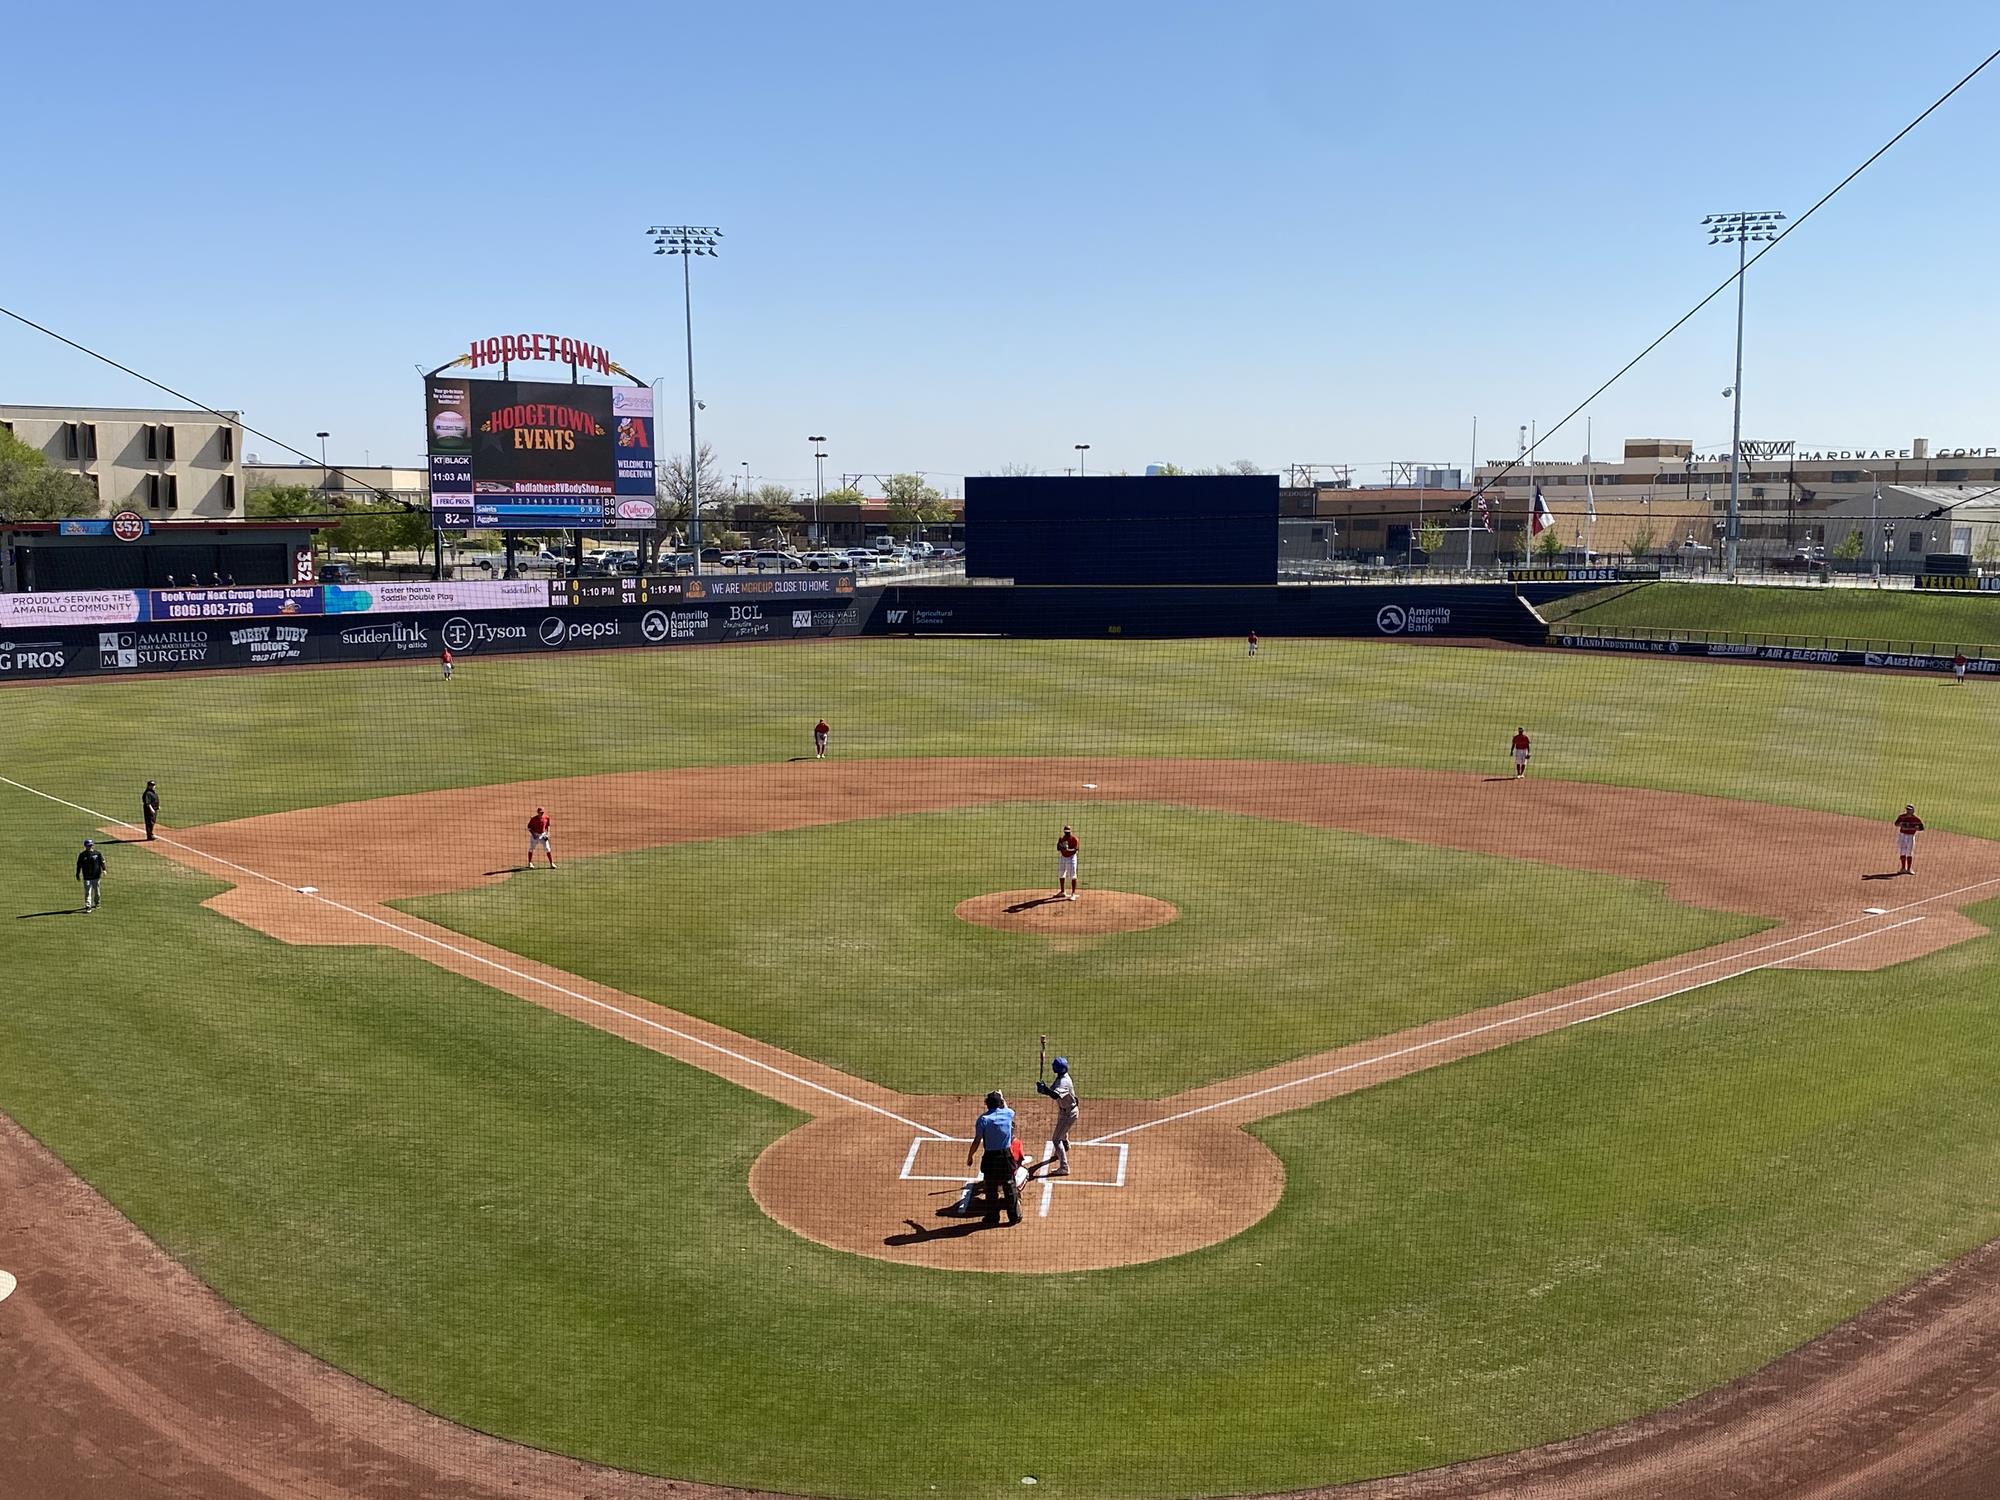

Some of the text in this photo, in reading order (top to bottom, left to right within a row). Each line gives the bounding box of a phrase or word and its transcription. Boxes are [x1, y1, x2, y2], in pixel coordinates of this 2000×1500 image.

[470, 333, 609, 376] HODGETOWN
[491, 404, 595, 436] HODGETOWN
[514, 428, 574, 450] EVENTS
[1799, 450, 1910, 460] HARDWARE
[1939, 448, 1997, 458] COMP
[618, 460, 652, 468] WELCOME TO
[433, 472, 454, 480] 11:03
[619, 470, 652, 478] HODGETOWN
[445, 514, 460, 524] 82
[116, 521, 140, 532] 352
[297, 552, 312, 581] 352
[553, 580, 579, 591] PIT 0
[622, 578, 647, 589] CIN 0
[711, 583, 724, 594] WE
[725, 582, 740, 593] ARE
[774, 581, 797, 592] CLOSE
[799, 580, 807, 592] TO
[161, 588, 313, 601] Book Your Next Group Outing Today!
[582, 587, 615, 596] 1:10 PM
[650, 585, 681, 594] 1:15 PM
[13, 594, 131, 605] PROUDLY SERVING THE
[551, 595, 568, 606] MIN
[573, 595, 579, 605] 0
[622, 592, 647, 603] STL 0
[13, 604, 131, 614] AMARILLO COMMUNITY
[170, 603, 254, 616] (806) 803-7768
[671, 610, 708, 619] Amarillo
[730, 605, 762, 620] BCL
[916, 610, 953, 618] Agricultural
[1408, 607, 1450, 616] Amarillo
[887, 610, 908, 623] WT
[1408, 615, 1450, 624] National
[671, 619, 708, 628] National
[1408, 624, 1434, 632] Bank
[342, 621, 429, 644] suddenlink
[474, 623, 526, 642] Tyson
[569, 619, 618, 640] pepsi
[671, 628, 694, 637] Bank
[138, 632, 208, 644] AMARILLO
[230, 626, 308, 645] BOBBY DUBY
[104, 636, 132, 647] A O
[251, 642, 289, 652] motors
[17, 652, 65, 668] PROS
[103, 654, 132, 664] M S
[138, 648, 207, 663] SURGERY
[1792, 650, 1839, 662] ELECTRIC
